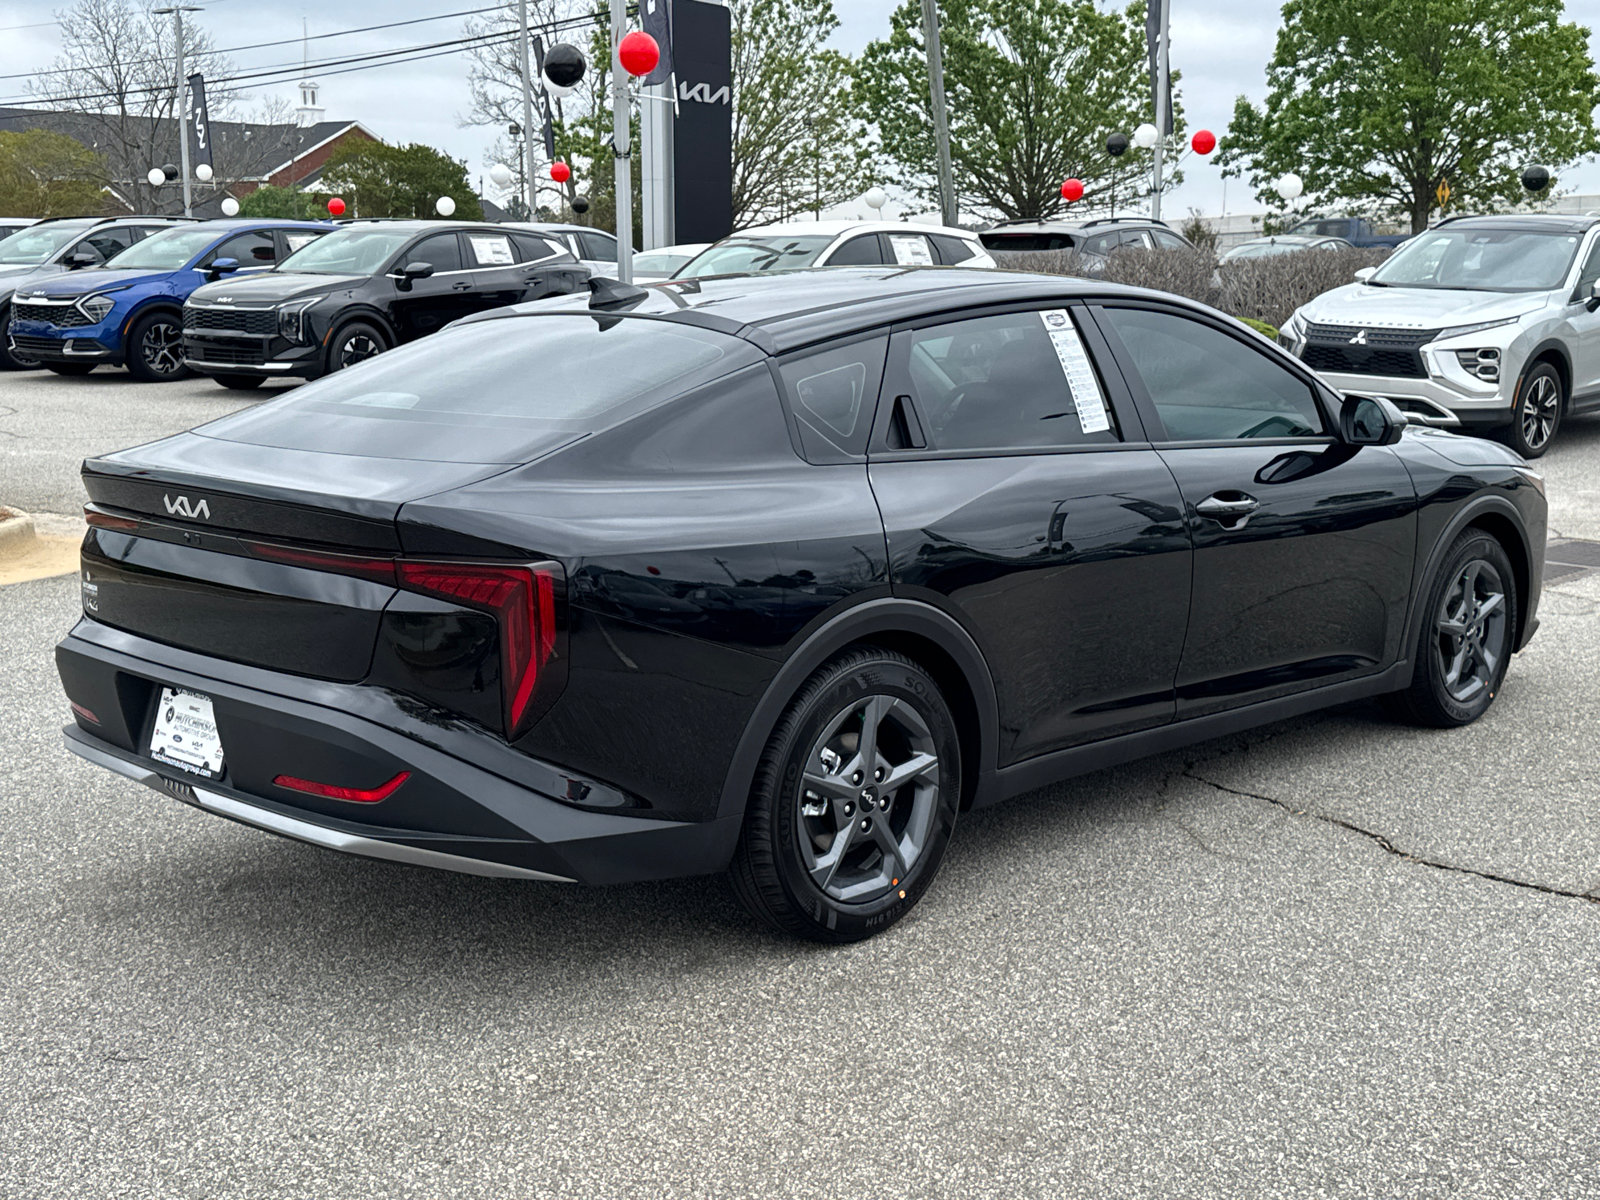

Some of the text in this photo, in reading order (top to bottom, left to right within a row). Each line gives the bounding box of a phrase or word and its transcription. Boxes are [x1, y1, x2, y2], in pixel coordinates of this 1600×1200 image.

[679, 80, 730, 106] KIA
[163, 493, 211, 520] KIA
[780, 762, 798, 851] KUMHO
